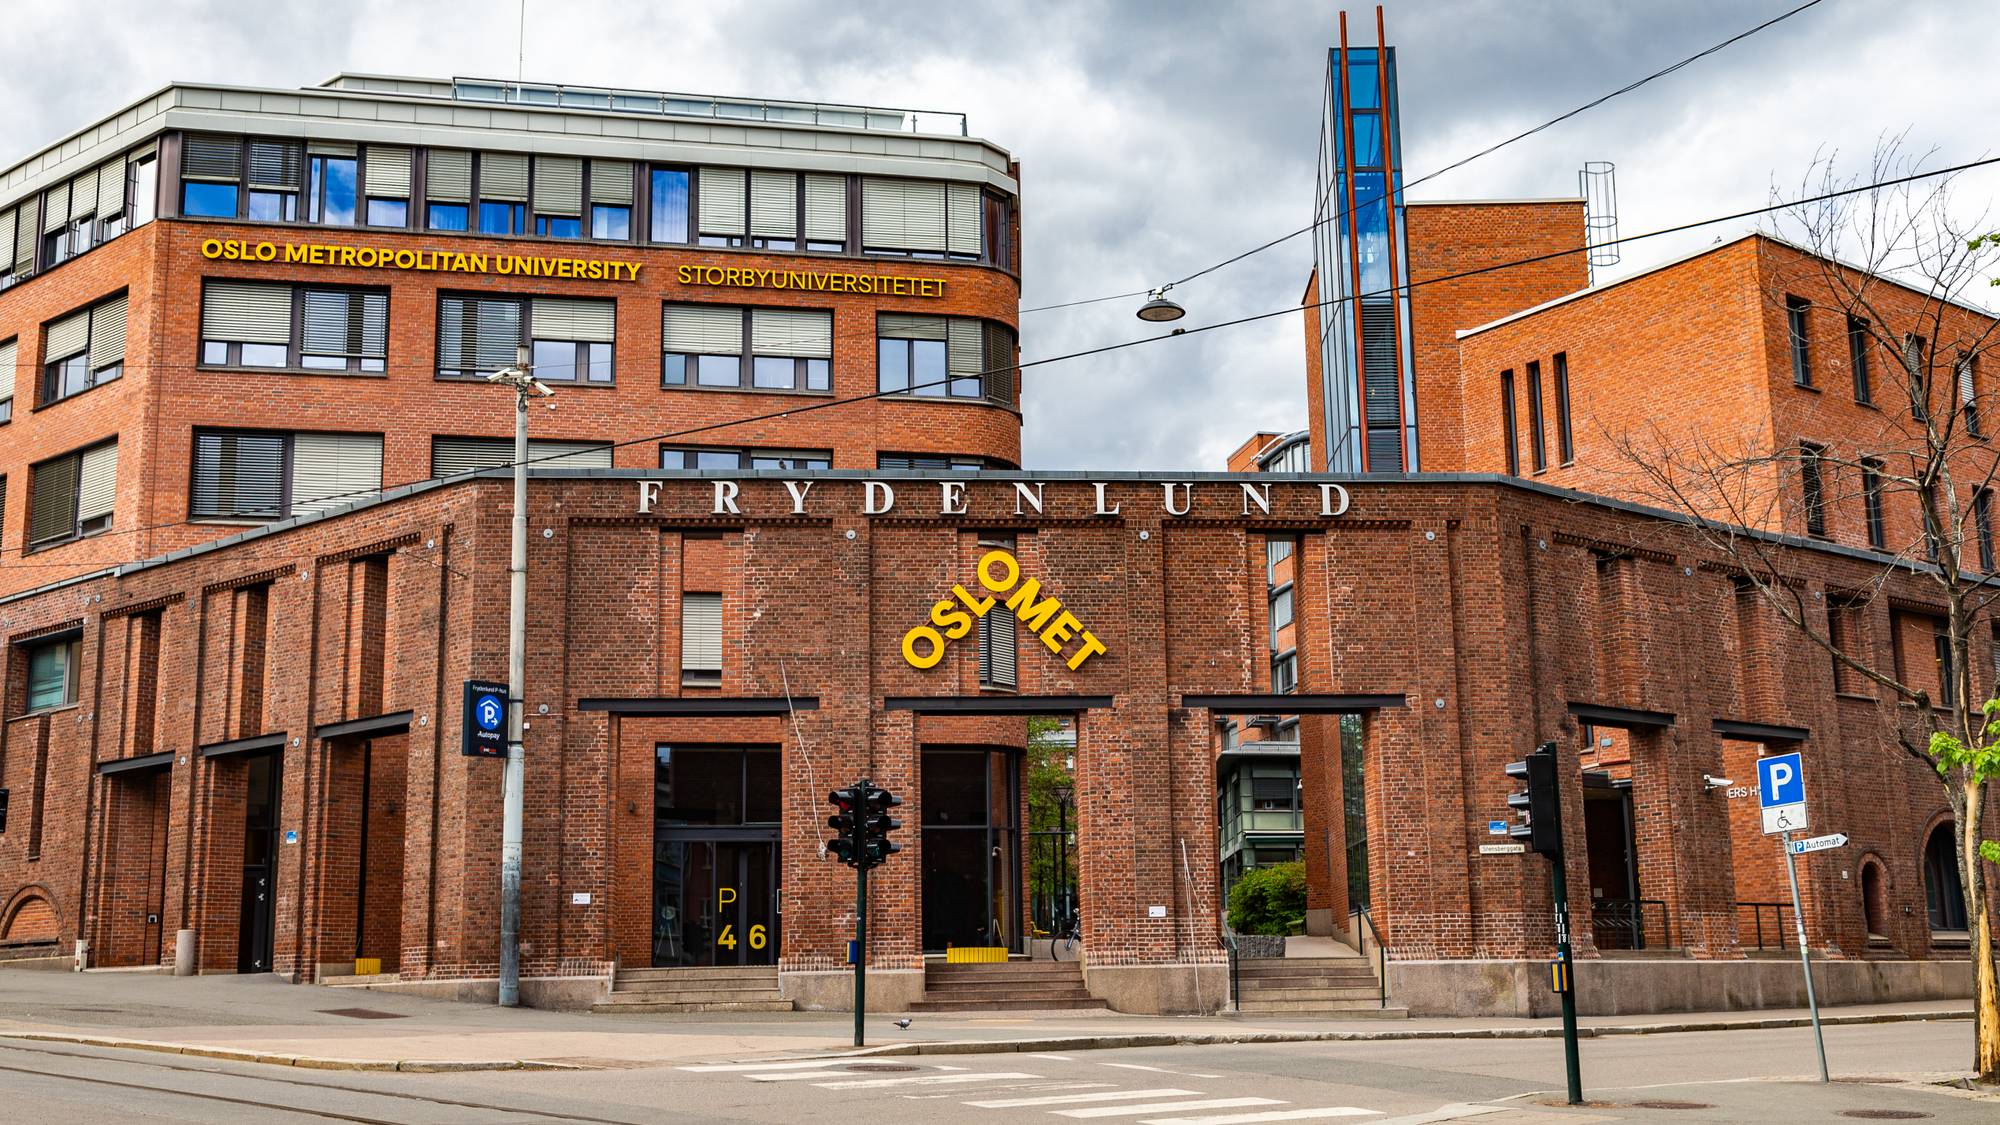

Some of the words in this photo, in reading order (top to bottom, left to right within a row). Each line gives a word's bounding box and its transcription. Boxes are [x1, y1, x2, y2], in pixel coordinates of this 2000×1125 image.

[201, 239, 277, 262] OSLO
[284, 243, 489, 273] METROPOLITAN
[496, 254, 642, 281] UNIVERSITY
[678, 265, 946, 297] STORBYUNIVERSITETET
[636, 481, 1350, 516] FRYDENLUND
[477, 730, 500, 741] Autopay
[1726, 786, 1748, 799] ERS
[1769, 763, 1793, 801] P
[1805, 837, 1840, 850] Automat
[719, 887, 737, 912] P
